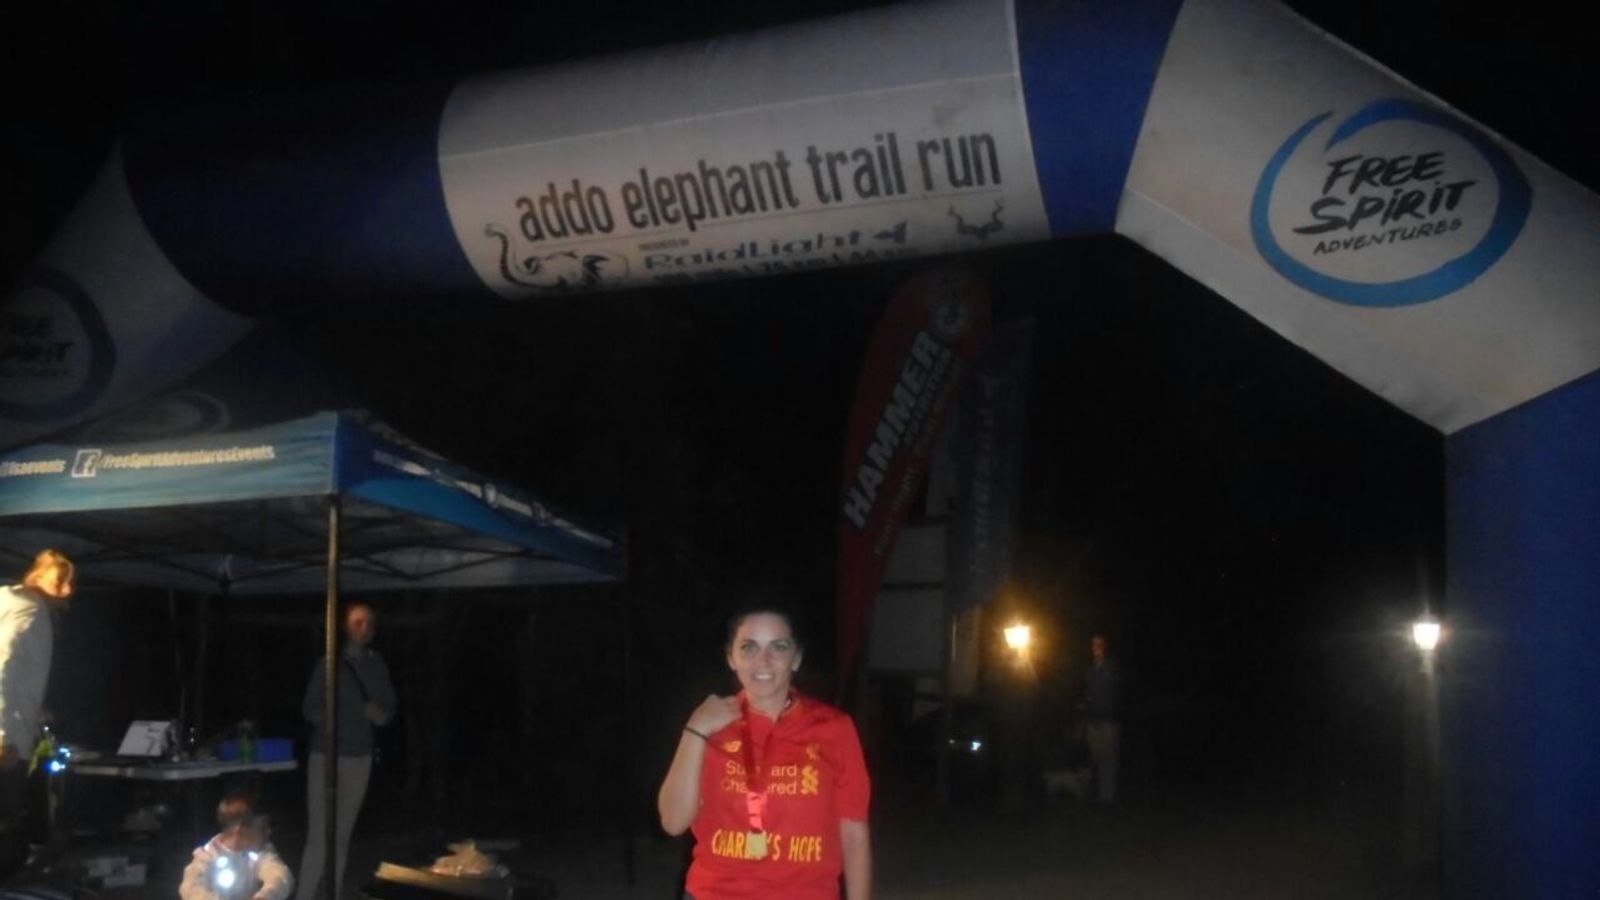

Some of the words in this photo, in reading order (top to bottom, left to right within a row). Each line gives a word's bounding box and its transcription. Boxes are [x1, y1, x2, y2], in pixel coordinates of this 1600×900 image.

[515, 178, 615, 242] addo
[620, 150, 800, 232] elephant
[806, 132, 907, 204] trail
[917, 133, 1001, 191] run
[1321, 151, 1446, 195] FREE
[1313, 218, 1463, 255] ADVENTURES
[843, 331, 941, 530] HAMMER
[788, 835, 822, 862] HOPE
